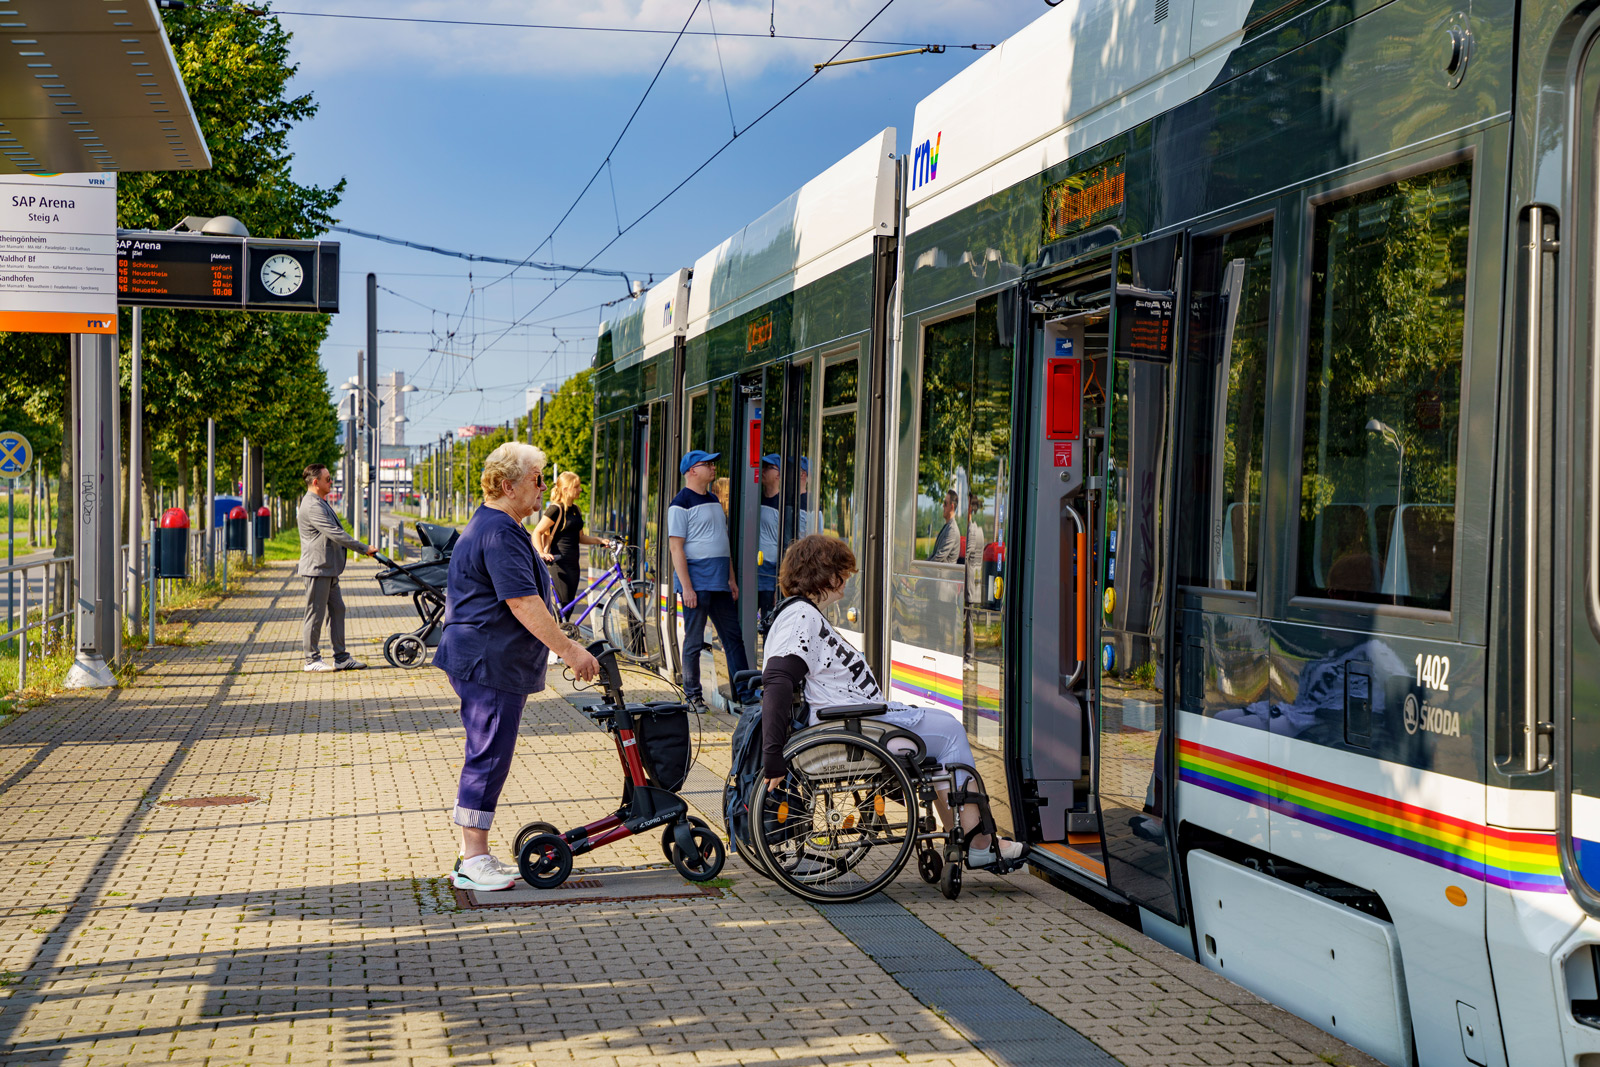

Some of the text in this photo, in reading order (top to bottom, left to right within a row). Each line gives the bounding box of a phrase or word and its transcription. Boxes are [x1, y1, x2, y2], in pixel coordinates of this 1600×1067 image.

[912, 131, 942, 192] rnv
[12, 196, 75, 209] SAP Arena
[28, 213, 60, 224] Steig A
[133, 240, 161, 250] Arena
[212, 288, 232, 296] 10:08
[88, 320, 112, 328] rnv
[1415, 653, 1450, 692] 1402
[1419, 700, 1460, 738] ŠKODA
[644, 817, 661, 826] TOPRO
